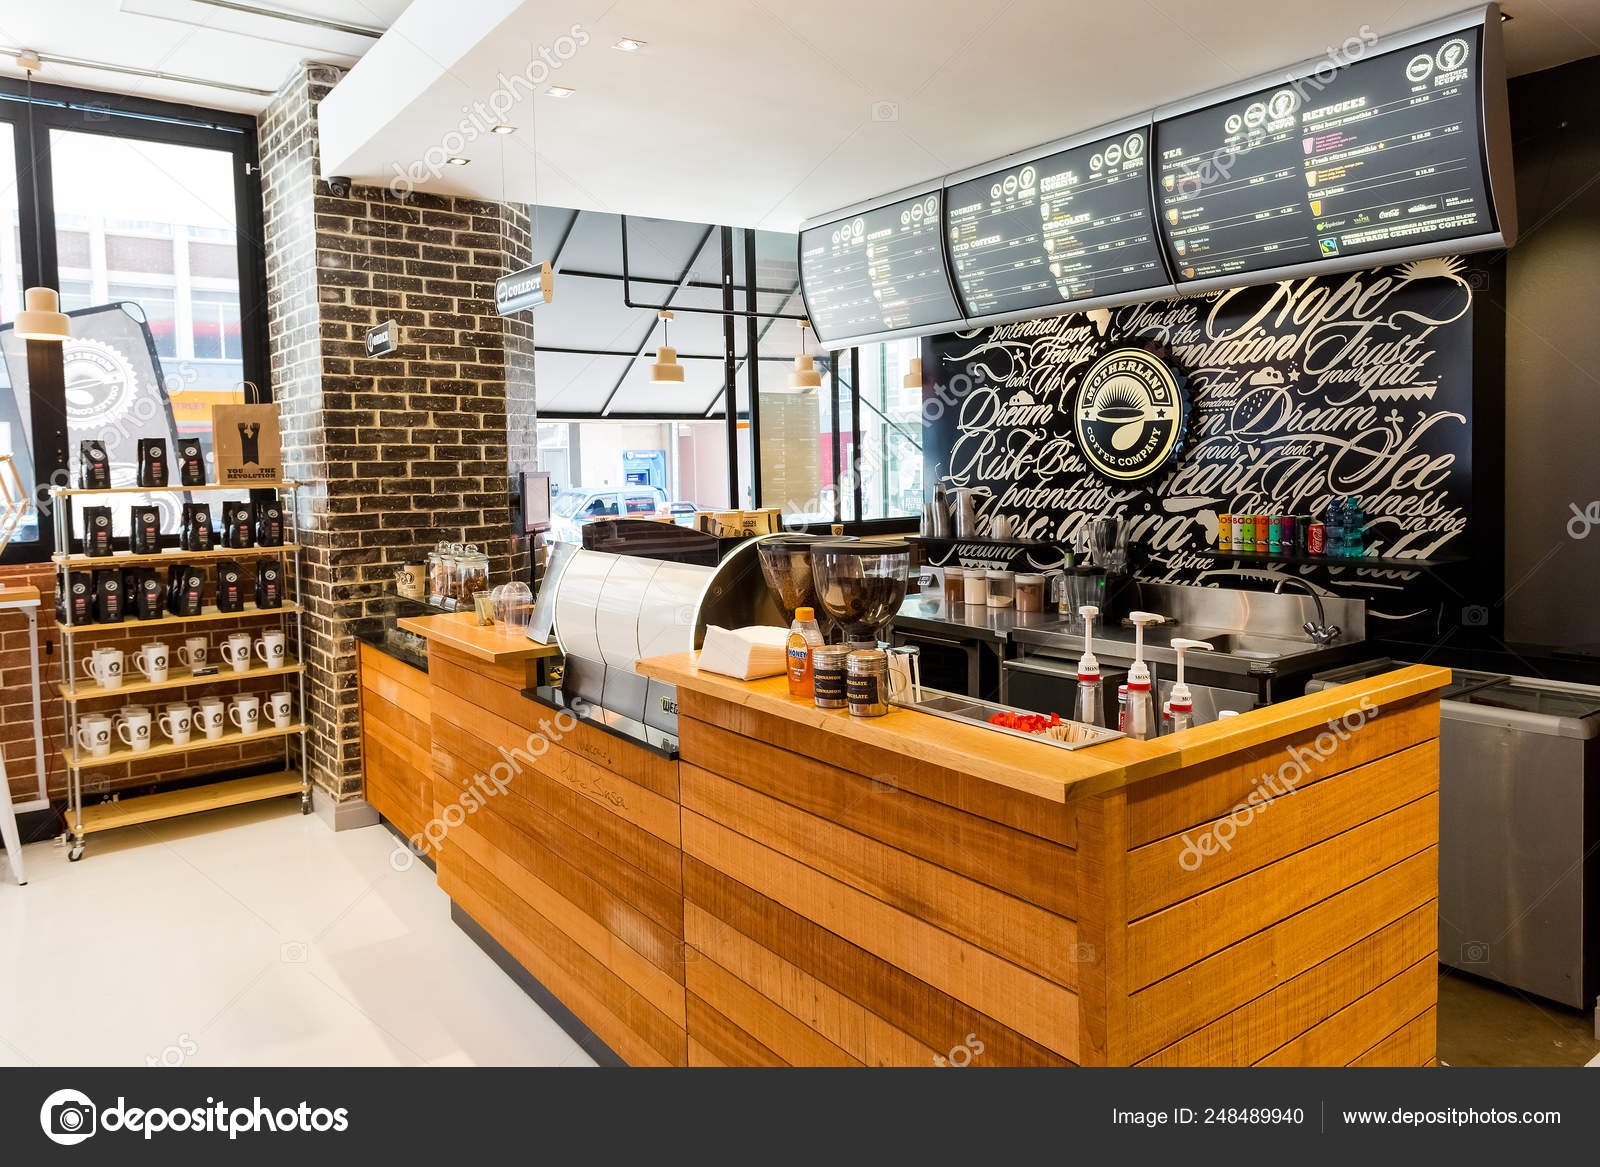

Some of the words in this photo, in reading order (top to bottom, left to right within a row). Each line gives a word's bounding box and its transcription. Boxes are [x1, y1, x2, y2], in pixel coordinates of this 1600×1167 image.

[1302, 96, 1366, 122] REFUGEES
[1163, 148, 1183, 159] TEA
[1342, 233, 1390, 246] FAIRTRADE
[1390, 225, 1437, 239] CERTIFIED
[508, 277, 542, 298] COLLECT
[1171, 320, 1201, 344] the
[1086, 360, 1166, 402] MOTHERLAND
[1225, 385, 1378, 442] Dream
[1087, 426, 1116, 465] COFFEE
[1117, 426, 1161, 466] COMPANY
[789, 648, 808, 660] HONEY
